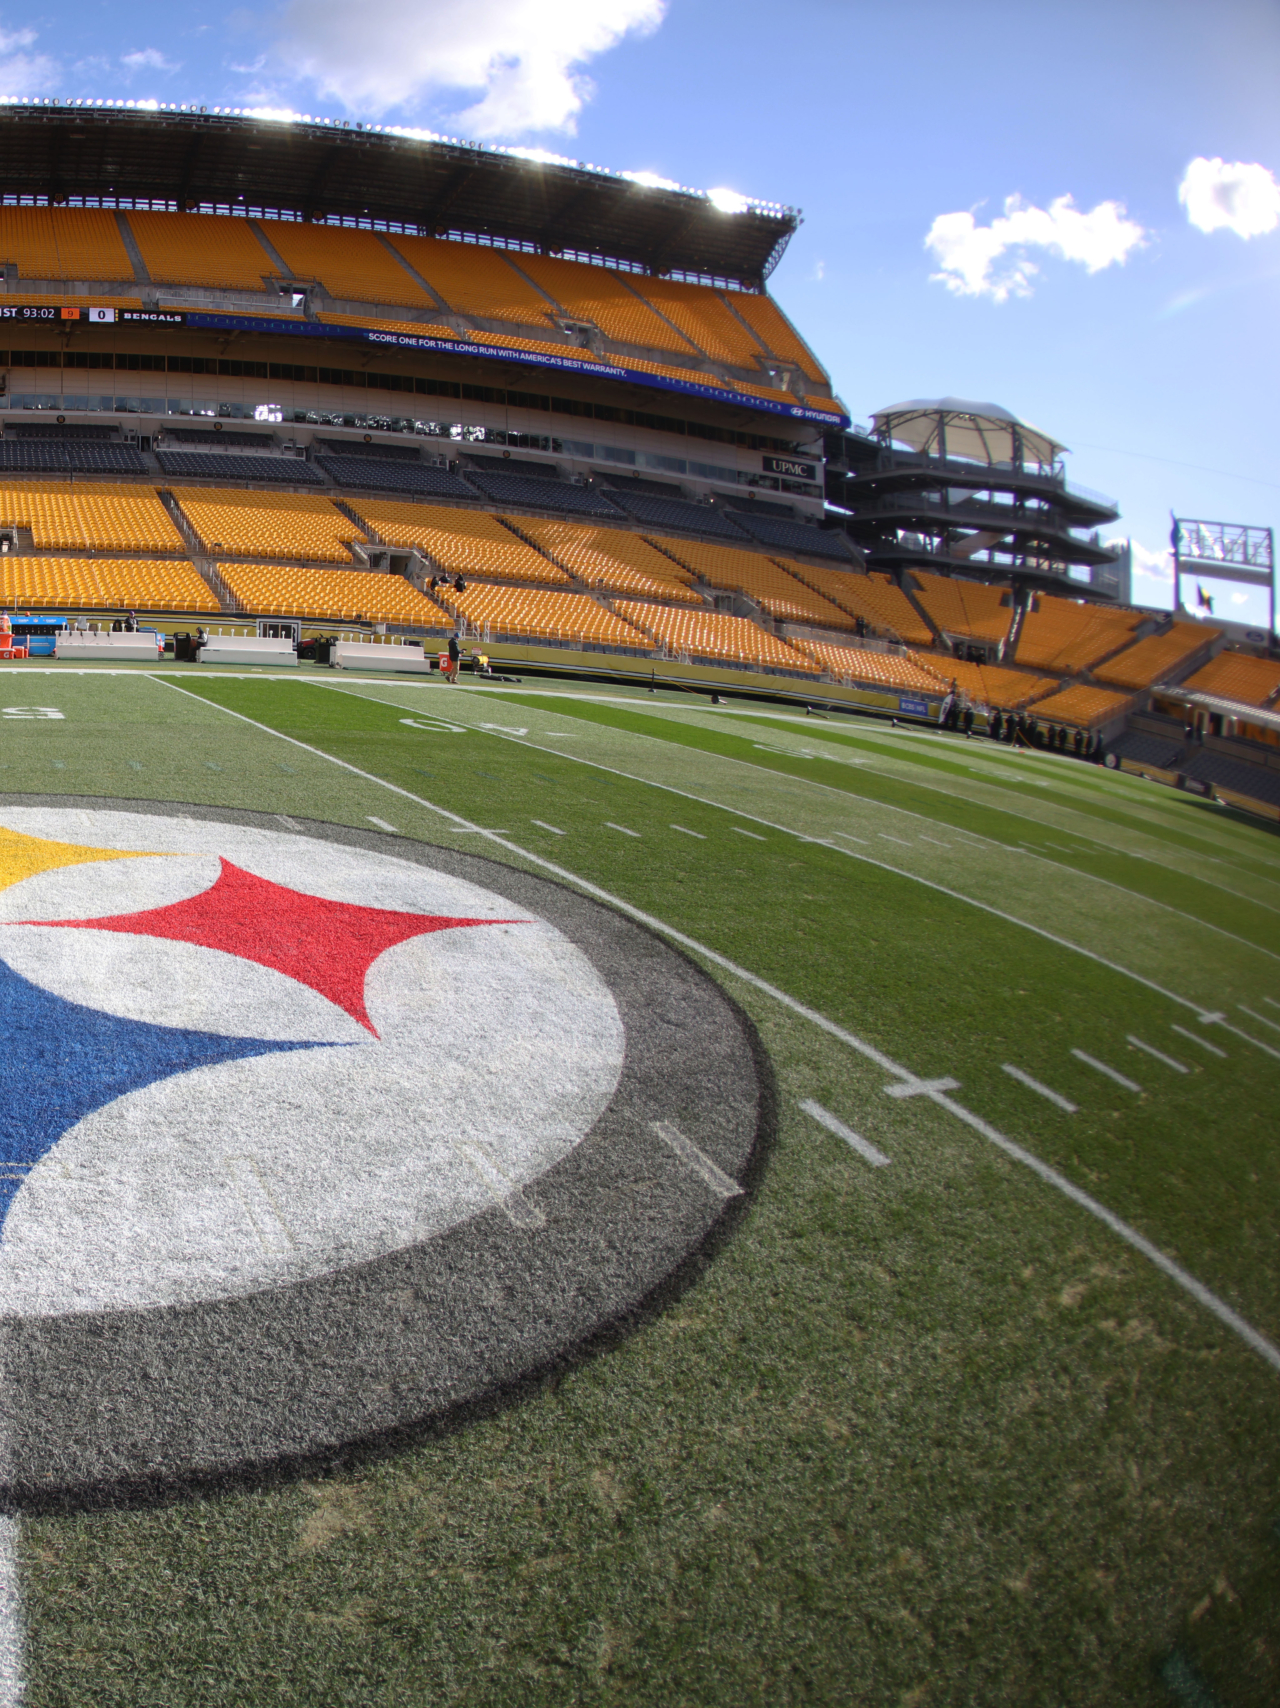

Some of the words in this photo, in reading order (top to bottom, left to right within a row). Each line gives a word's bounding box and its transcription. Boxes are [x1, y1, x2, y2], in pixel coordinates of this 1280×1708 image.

[23, 308, 55, 318] 93:02
[97, 310, 106, 320] 0
[123, 312, 182, 322] BENGALS
[368, 333, 397, 343] SCORE
[399, 337, 417, 346] ONE
[419, 339, 436, 348] FOR
[437, 341, 453, 350] THE
[454, 343, 478, 353] LONG
[479, 346, 497, 356] RUN
[498, 348, 519, 359] WITH
[520, 351, 562, 365] AMERICA'S
[563, 358, 582, 369] BEST
[583, 361, 627, 377] WARRANTY.
[805, 410, 841, 424] HYUNDAI
[772, 460, 808, 476] UPMC
[440, 657, 448, 667] G
